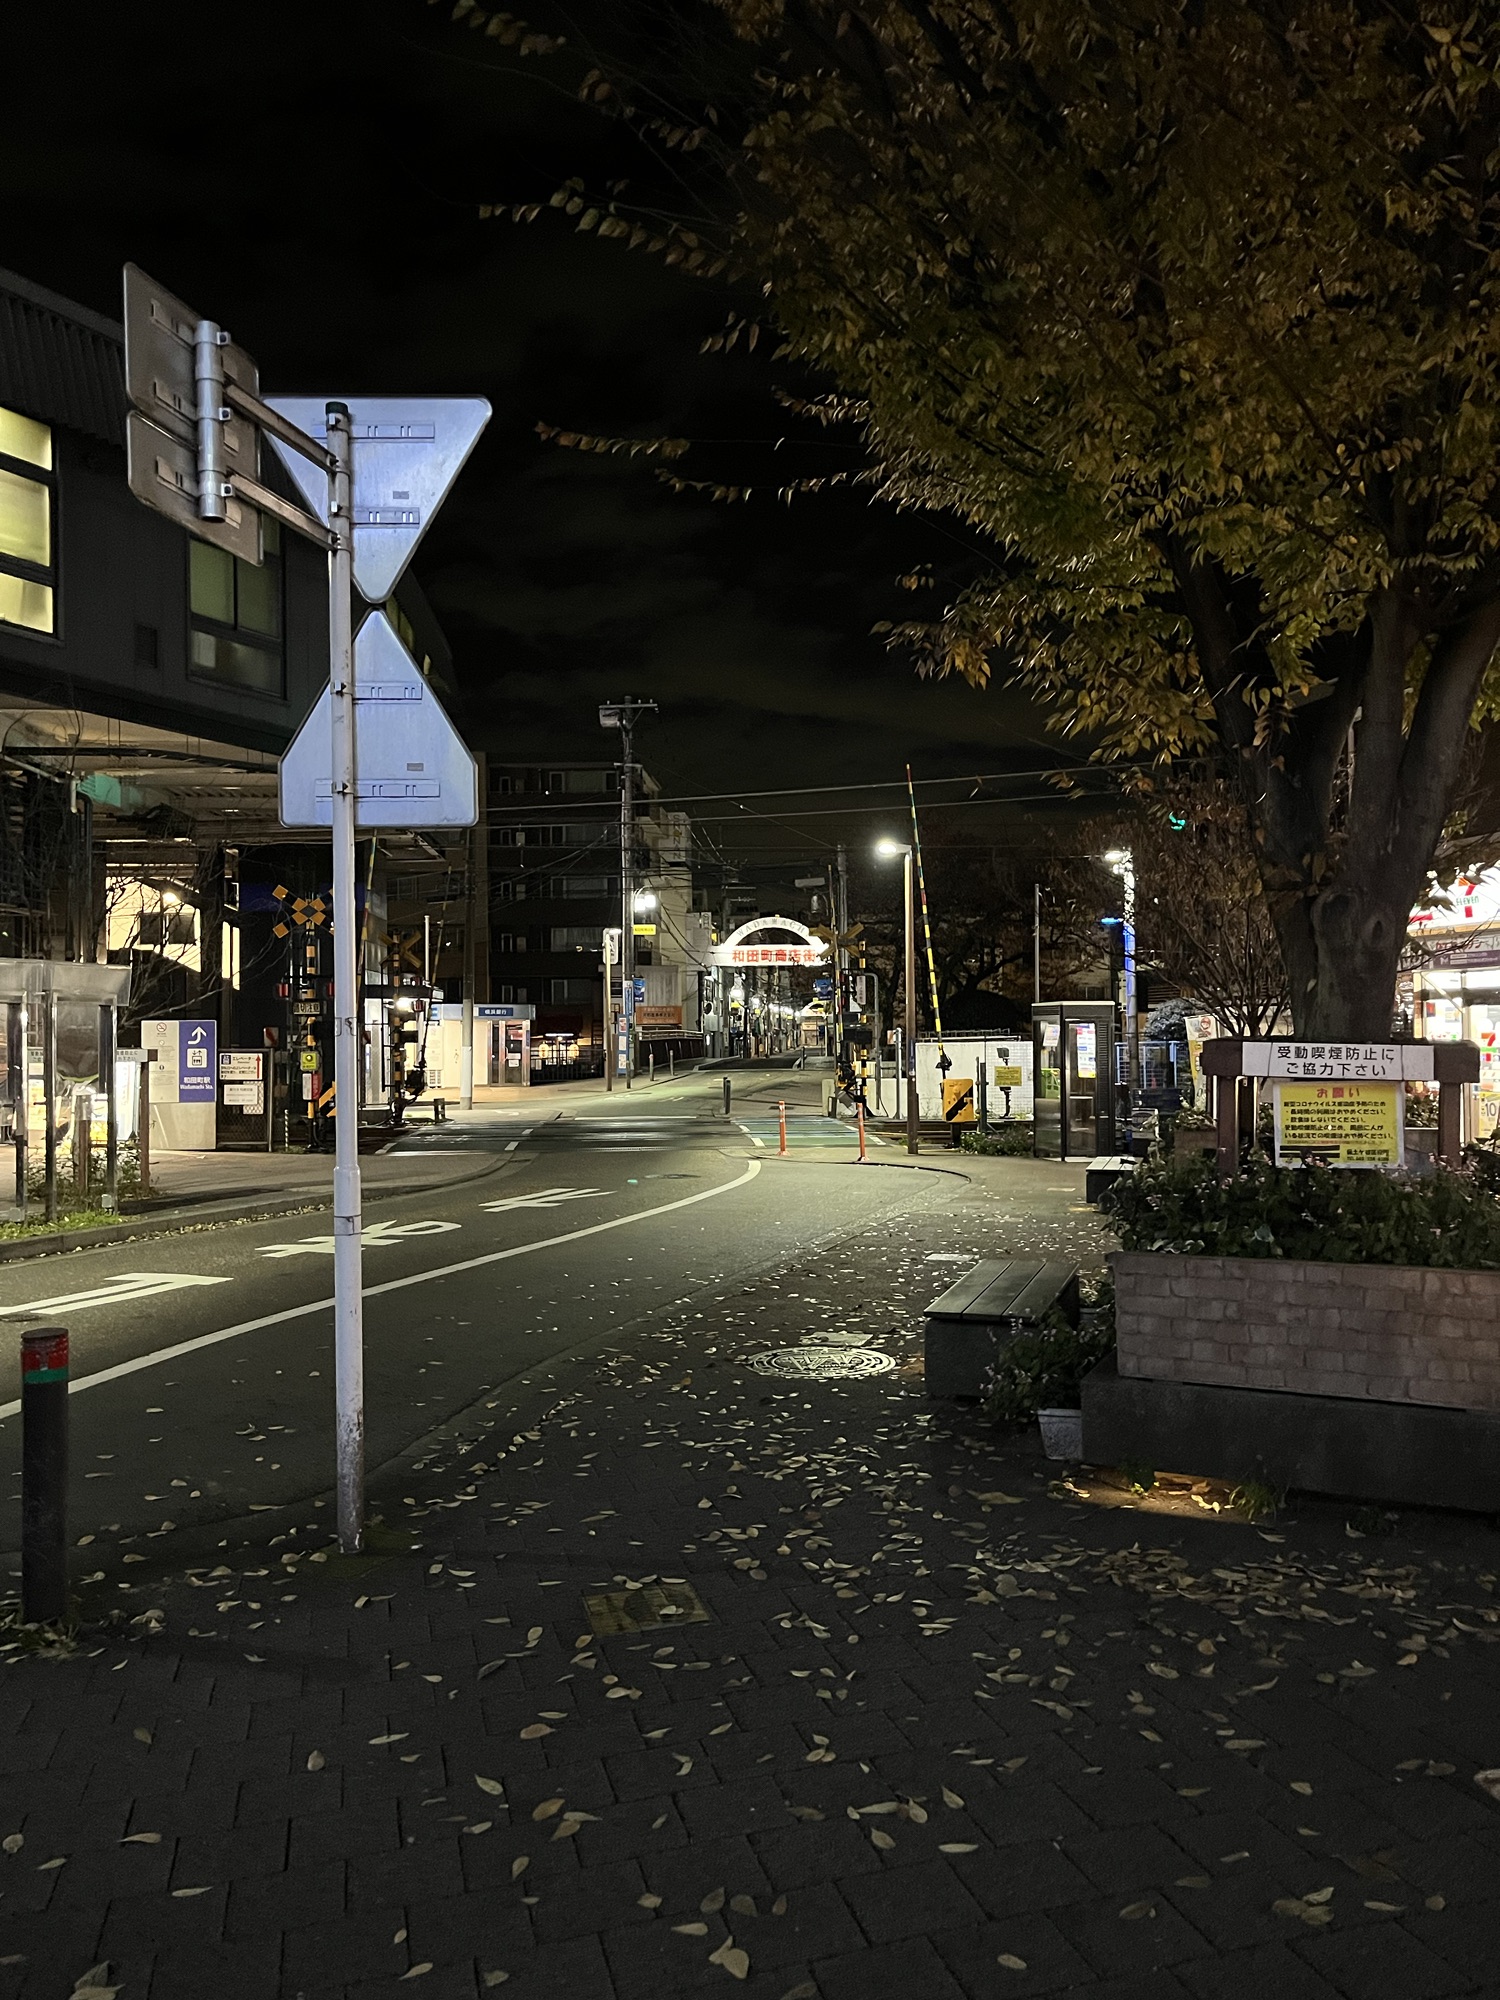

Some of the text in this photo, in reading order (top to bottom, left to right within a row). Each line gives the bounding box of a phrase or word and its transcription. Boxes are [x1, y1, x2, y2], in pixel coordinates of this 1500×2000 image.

[736, 918, 808, 937] WADAMACH
[732, 949, 816, 963] 和田町商店街
[1277, 1045, 1395, 1061] 受動喫煙防止に
[1286, 1062, 1386, 1076] ご協力下さい
[183, 1076, 211, 1084] 和田町駅
